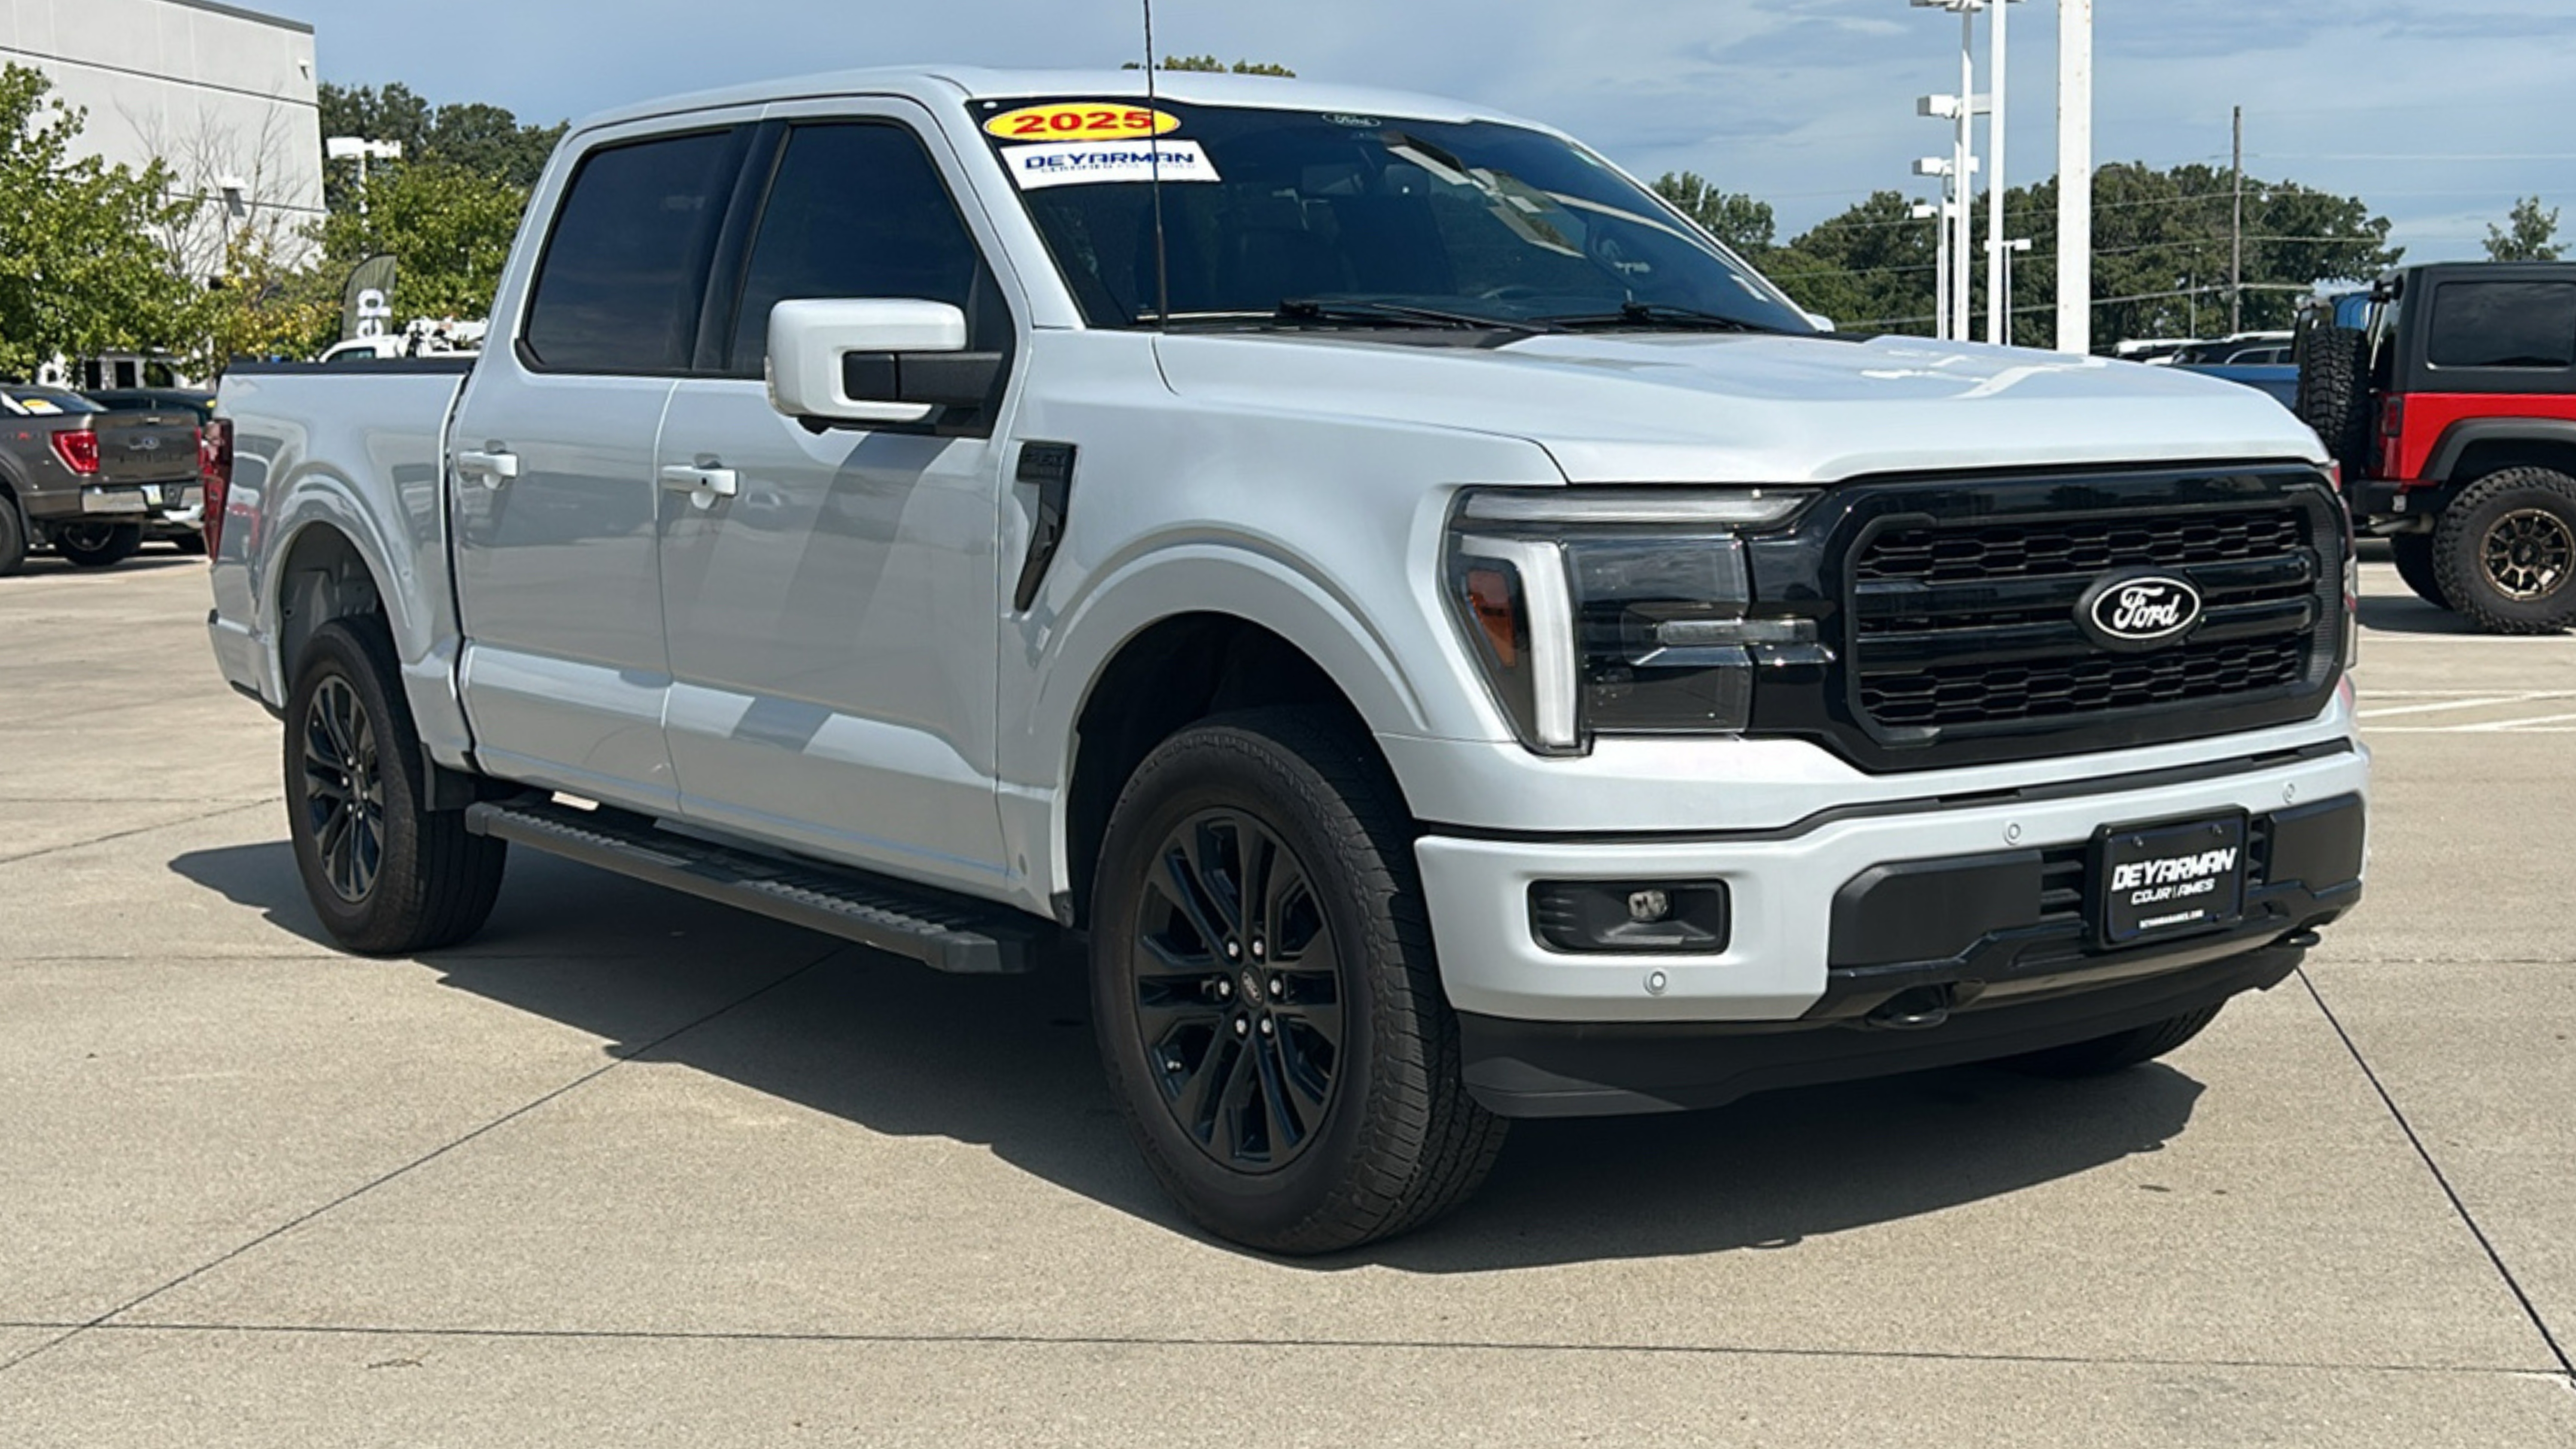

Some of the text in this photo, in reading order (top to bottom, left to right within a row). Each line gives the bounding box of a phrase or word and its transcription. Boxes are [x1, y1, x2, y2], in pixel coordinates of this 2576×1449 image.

[1012, 110, 1154, 134] 2025
[1025, 152, 1194, 169] DEYARMAN
[2112, 586, 2181, 629] Ford
[2111, 847, 2237, 892] DEYARMAN
[2176, 878, 2215, 898] AMES
